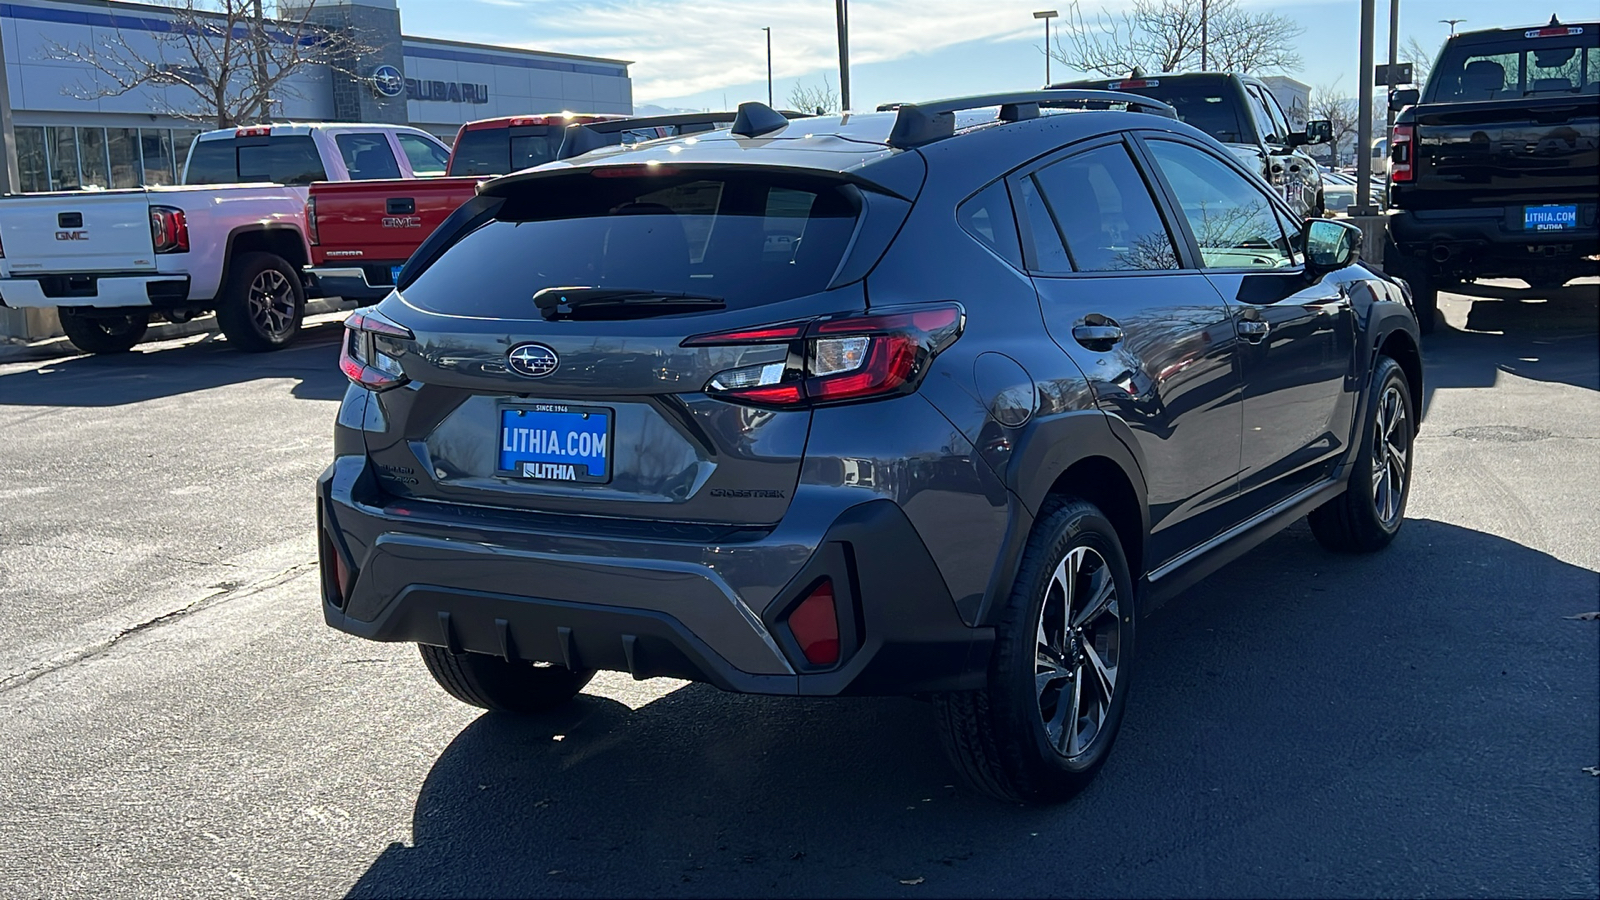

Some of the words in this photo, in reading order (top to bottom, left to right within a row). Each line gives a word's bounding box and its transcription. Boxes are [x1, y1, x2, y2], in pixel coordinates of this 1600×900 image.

[404, 78, 489, 104] SUBARU
[382, 217, 421, 227] GMC
[1525, 211, 1576, 223] LITHIA.COM
[55, 231, 89, 241] GMC
[536, 404, 553, 412] SINCE
[554, 405, 568, 413] 1946
[503, 427, 607, 458] LITHIA.COM
[534, 462, 576, 481] LITHIA
[710, 488, 785, 499] CROSSTREK
